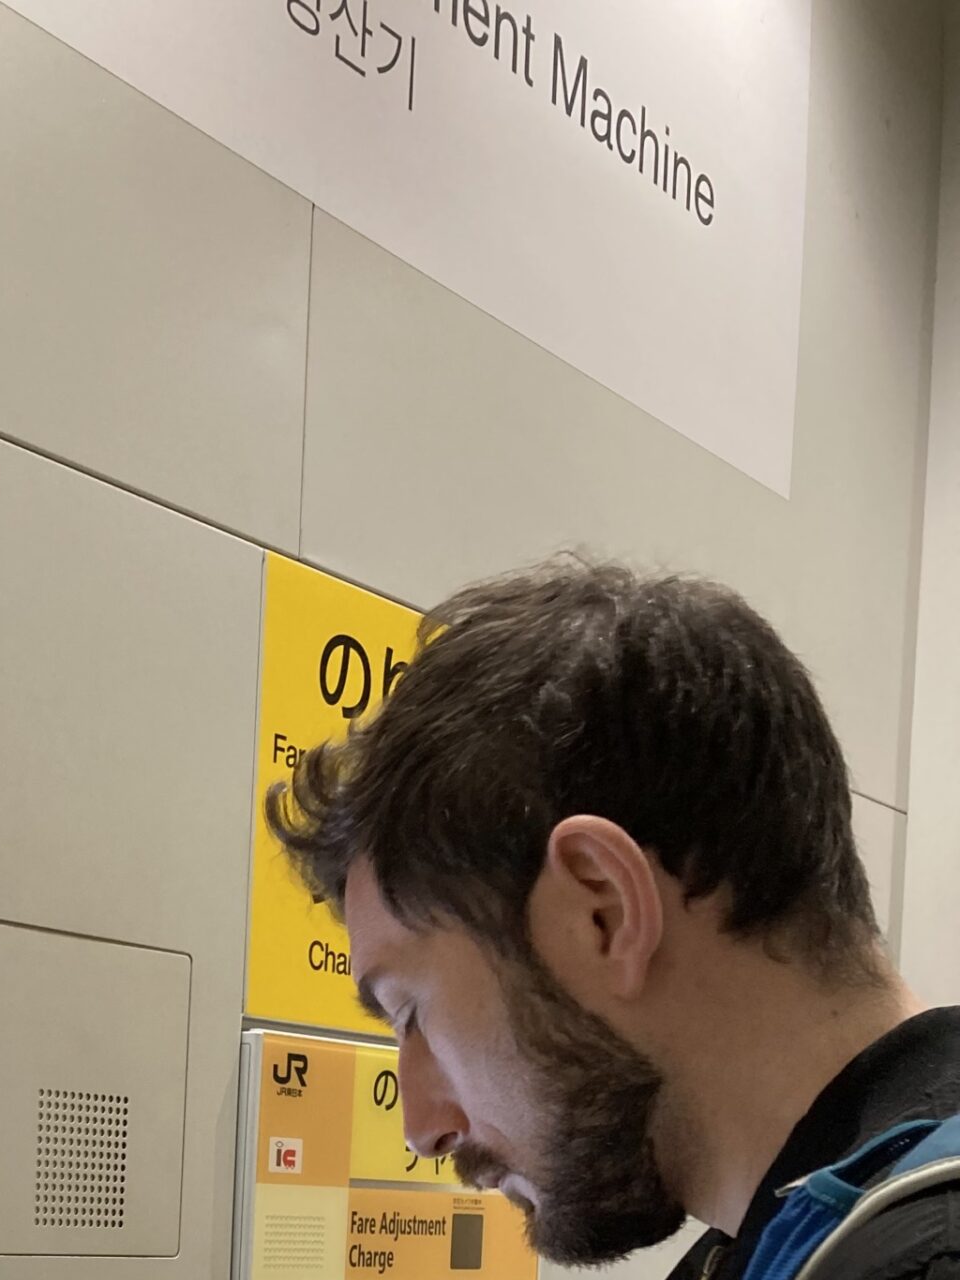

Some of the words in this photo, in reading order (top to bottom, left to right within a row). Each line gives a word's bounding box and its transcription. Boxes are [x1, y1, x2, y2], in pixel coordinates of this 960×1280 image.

[551, 33, 715, 227] Machine
[272, 1053, 308, 1087] JR
[350, 1211, 377, 1235] Fare
[379, 1211, 447, 1242] Adjustment
[349, 1244, 395, 1274] Charge
